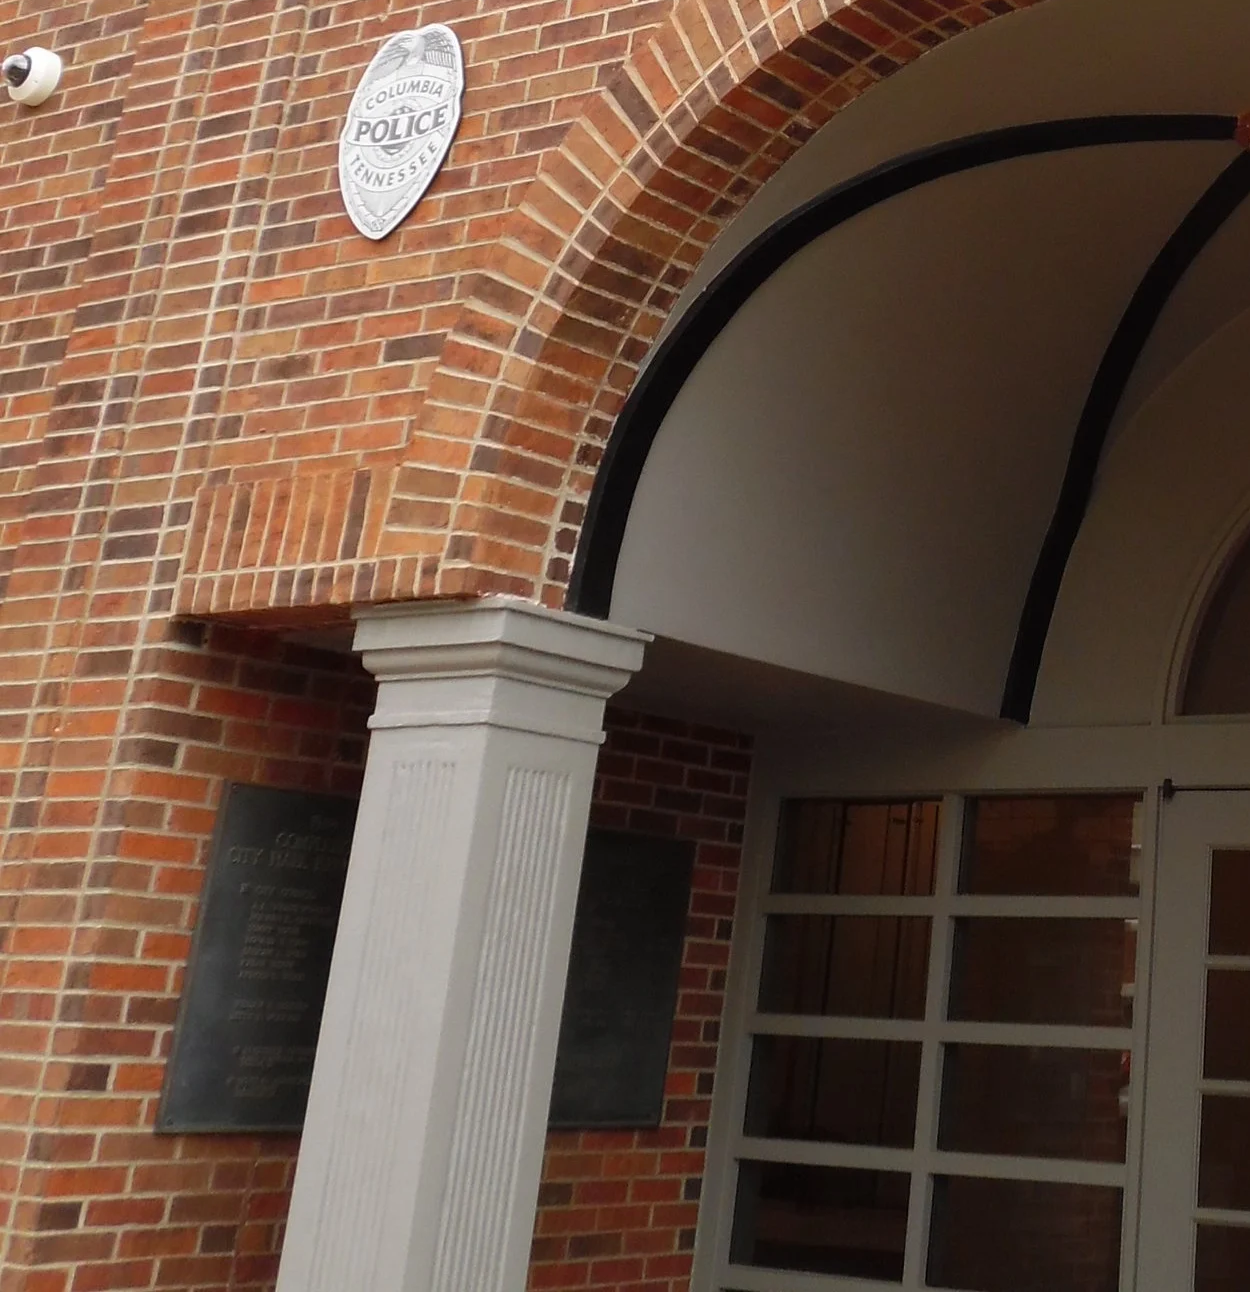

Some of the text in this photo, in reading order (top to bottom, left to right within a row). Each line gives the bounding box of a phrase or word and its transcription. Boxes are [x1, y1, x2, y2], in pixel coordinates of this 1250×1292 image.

[365, 80, 445, 111] COLUMBIA
[353, 103, 449, 142] POLICE
[349, 141, 438, 188] TENNESSEE
